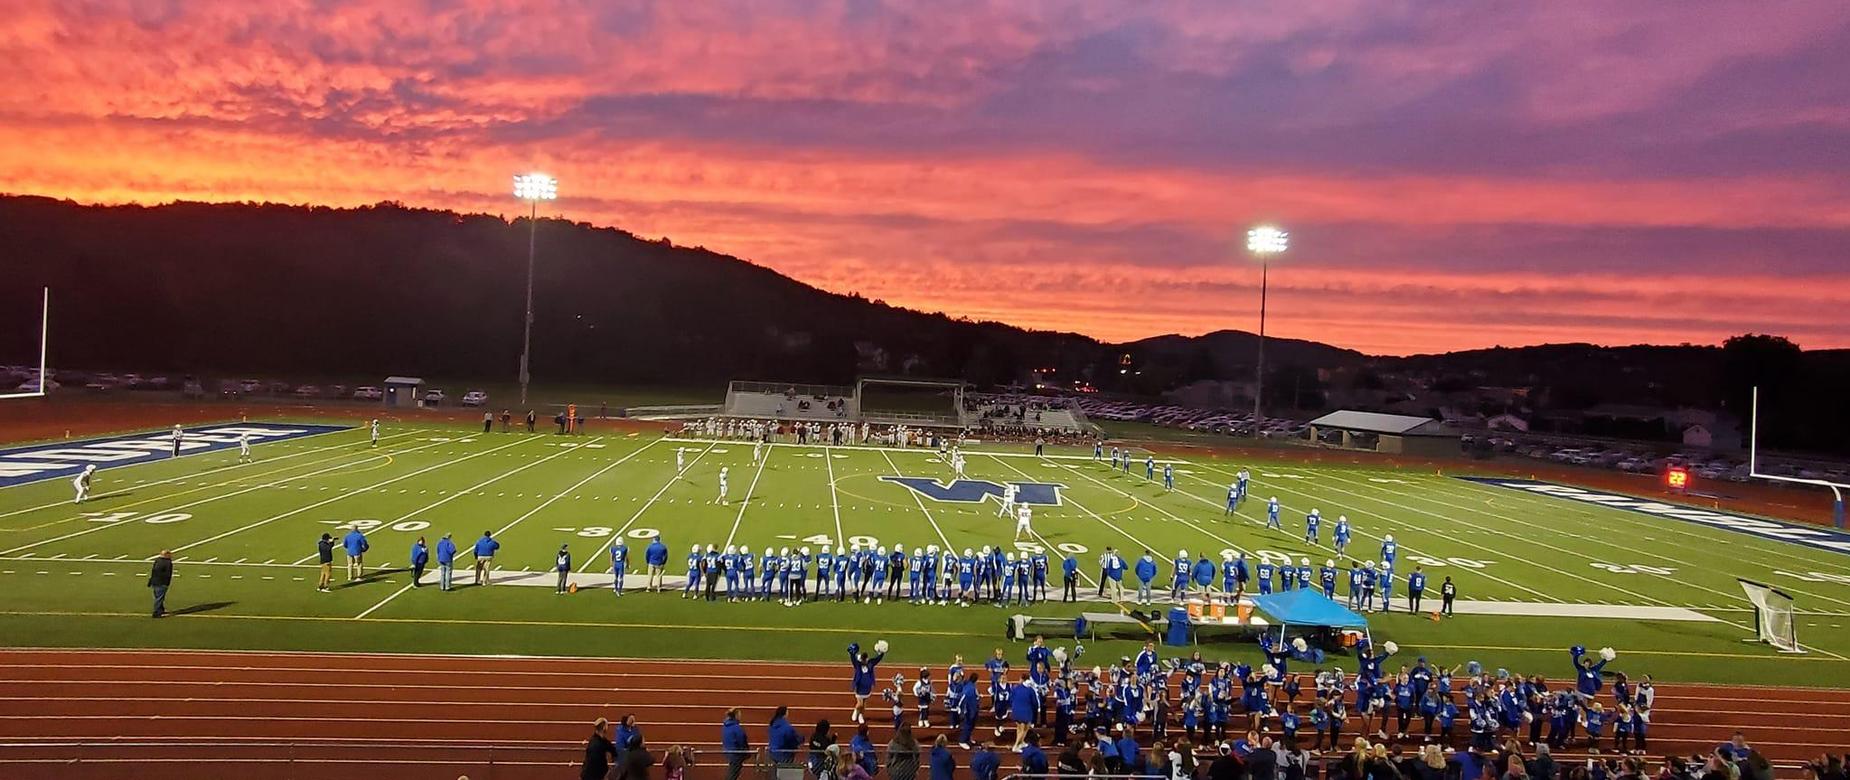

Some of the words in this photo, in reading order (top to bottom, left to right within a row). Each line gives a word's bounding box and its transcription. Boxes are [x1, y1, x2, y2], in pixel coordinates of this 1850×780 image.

[1669, 471, 1687, 485] 22
[577, 526, 660, 539] 30
[802, 534, 879, 547] 40
[1013, 541, 1089, 554] 50
[615, 551, 622, 561] 2
[911, 560, 921, 571] 10
[961, 563, 971, 573] 76
